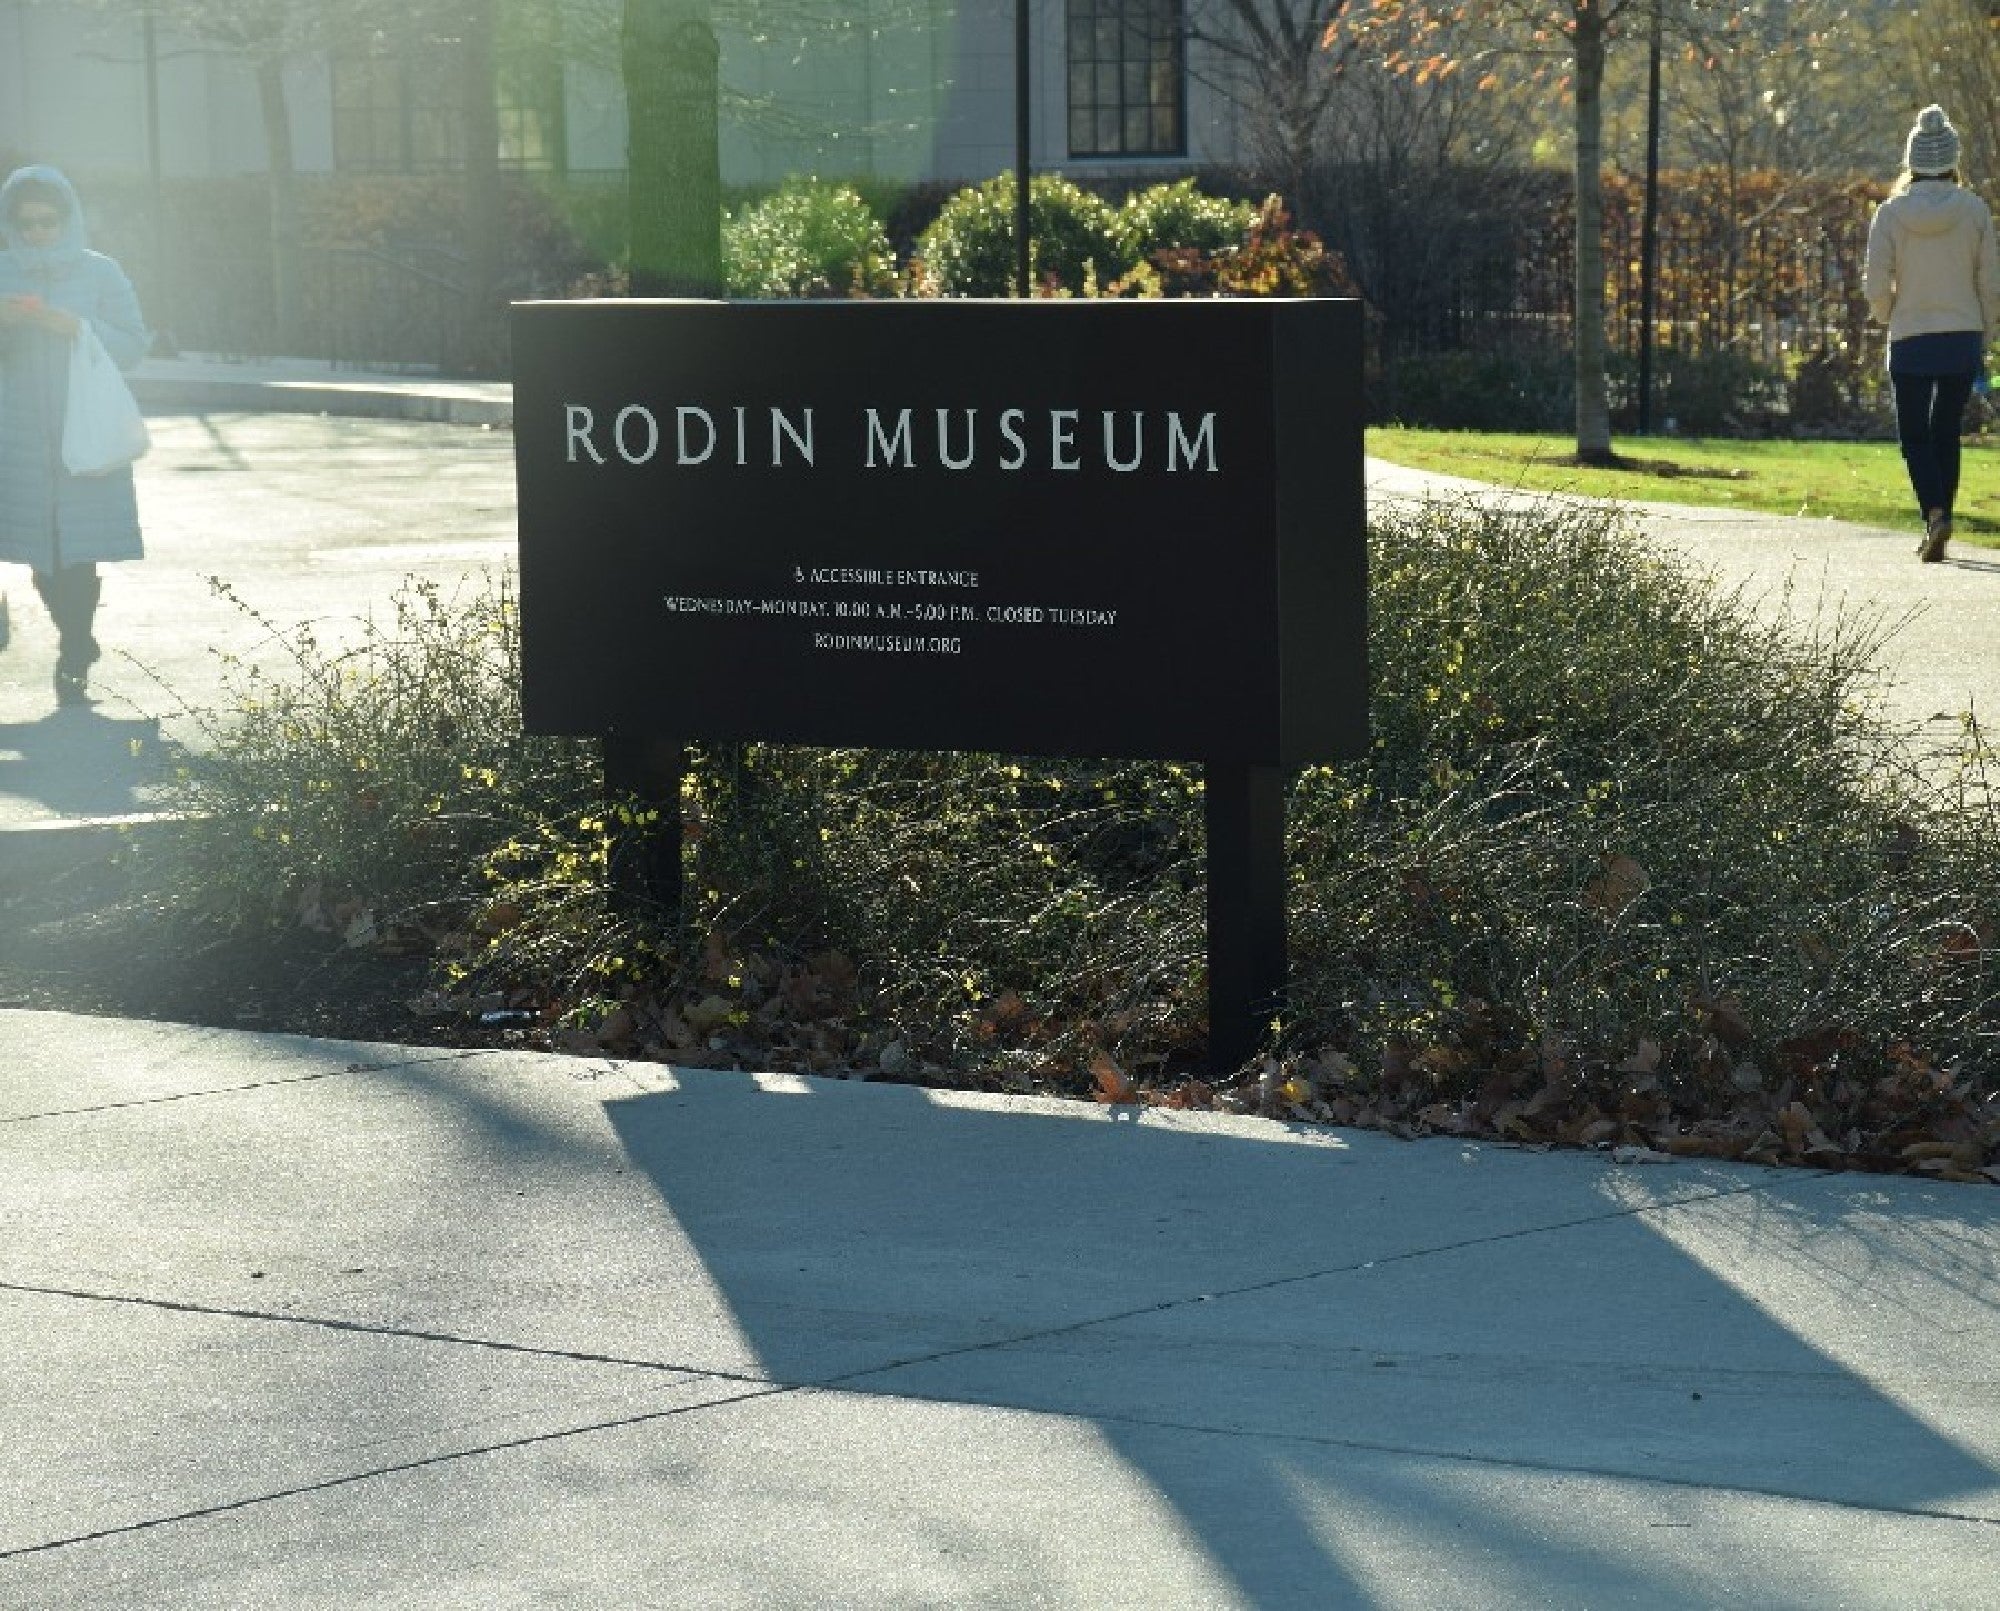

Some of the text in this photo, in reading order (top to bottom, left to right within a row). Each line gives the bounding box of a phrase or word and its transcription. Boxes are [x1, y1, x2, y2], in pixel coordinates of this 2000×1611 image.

[565, 404, 1220, 473] RODIN MUSEUM
[810, 568, 980, 588] ACCESSIBLE ENTRANCE
[986, 606, 1045, 624] CLOSED
[1048, 608, 1118, 626] TUESDAY
[815, 632, 962, 654] RODINMUSEUM.ORG
